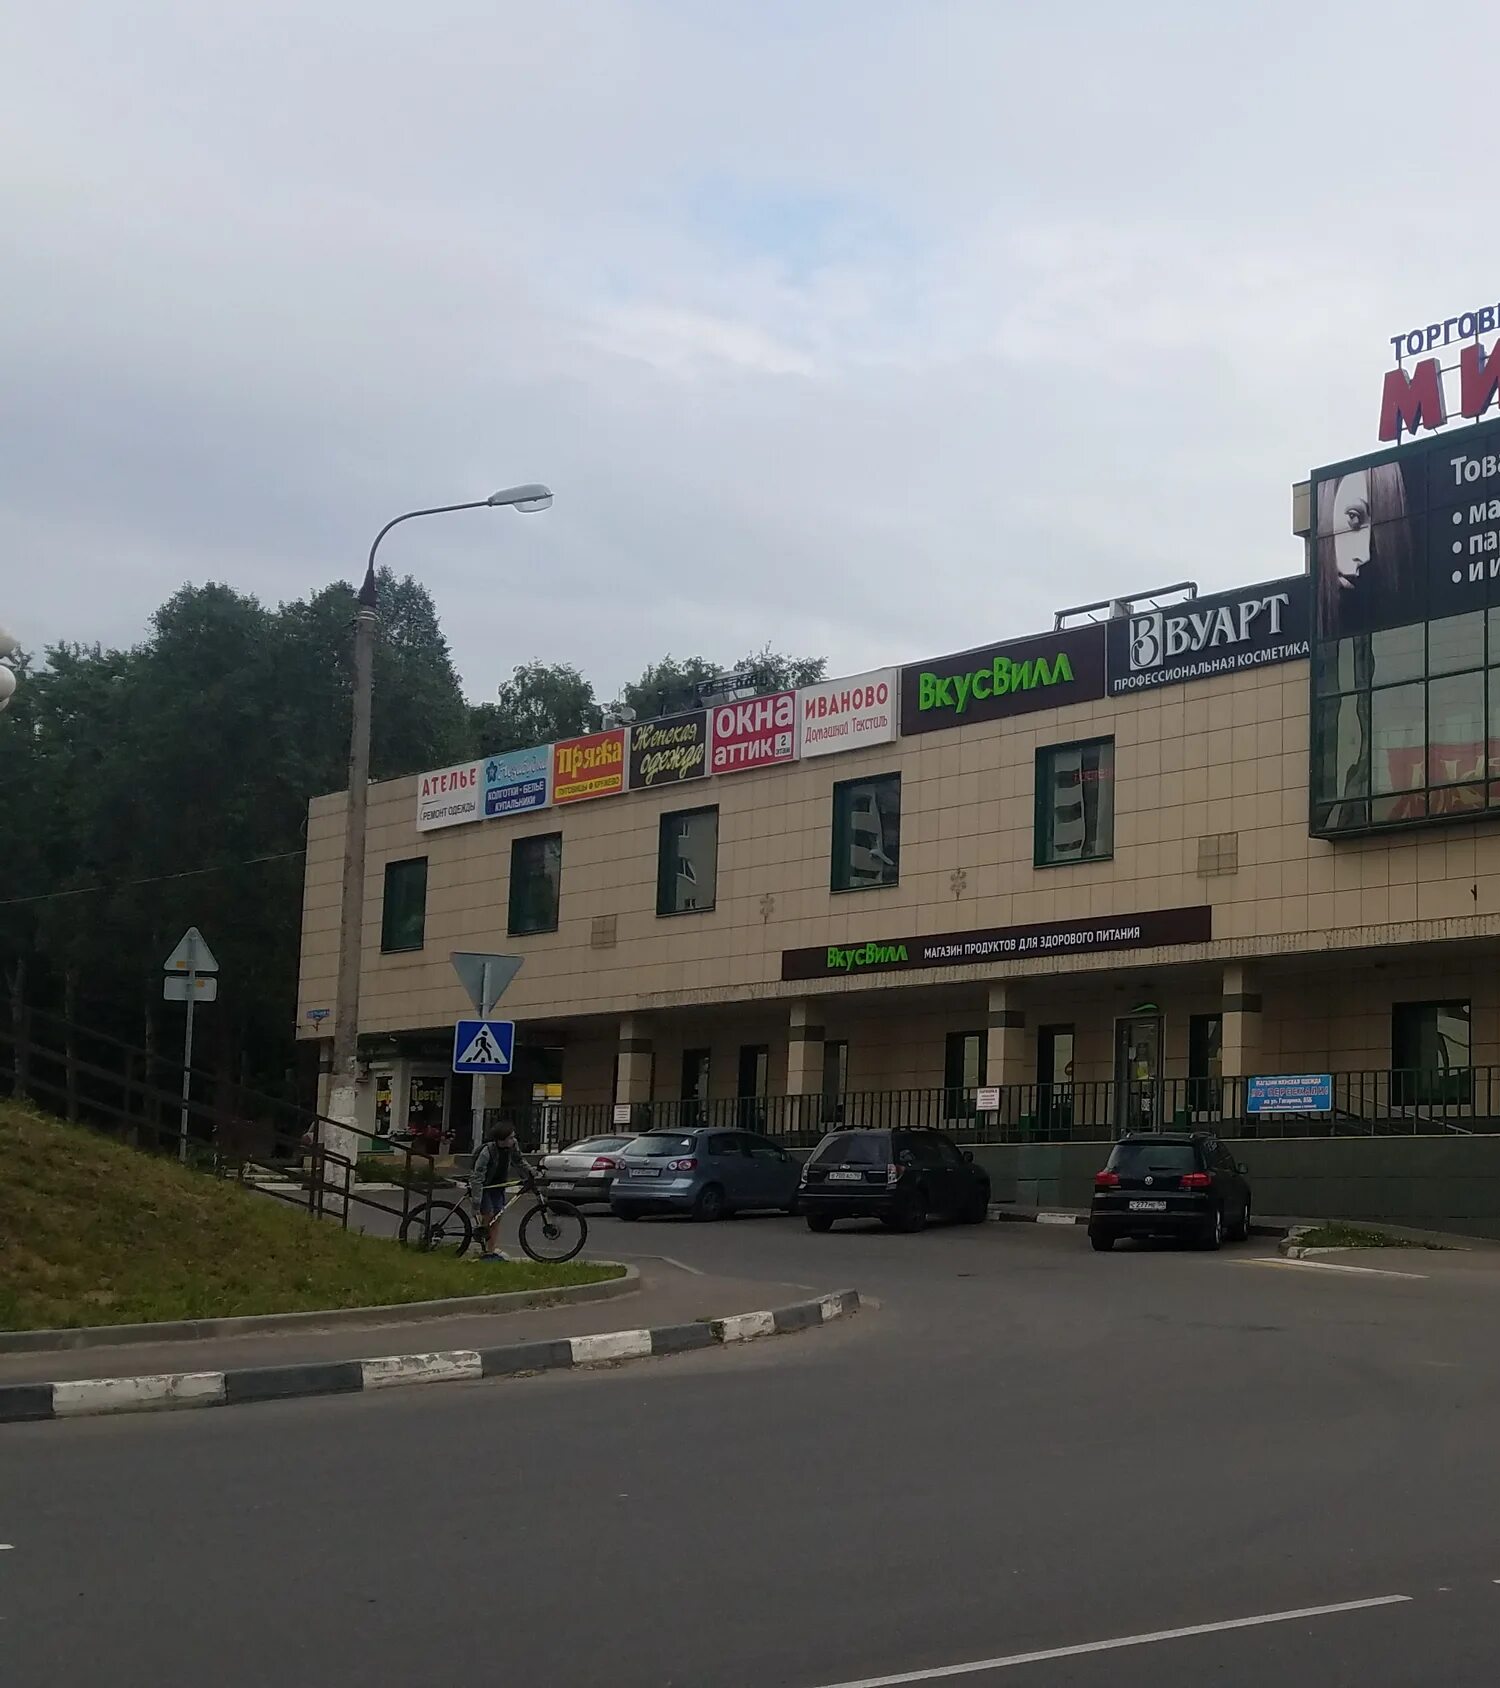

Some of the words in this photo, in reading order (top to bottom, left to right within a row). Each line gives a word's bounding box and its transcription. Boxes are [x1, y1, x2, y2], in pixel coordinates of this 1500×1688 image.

[1469, 562, 1483, 582] и
[1165, 593, 1289, 657] ВУАРТ
[1114, 655, 1235, 692] ПРОФЕССИОНАЛЬНАЯ
[1238, 641, 1310, 667] КОСМЕТИКА
[918, 653, 1074, 713] ВкусВилл
[805, 683, 888, 720] ИВАНОВО
[632, 723, 697, 751] Женская
[781, 735, 786, 747] 2
[804, 721, 848, 744] Домашний
[852, 715, 888, 733] Текстиль
[557, 739, 622, 778] Пряжа
[640, 743, 704, 785] одежда
[422, 768, 477, 797] АТЕЛЬЕ
[487, 787, 519, 801] КОЛГОТКИ
[523, 781, 544, 793] БЕЛЬЕ
[422, 807, 448, 821] РЕМОНТ
[449, 802, 475, 816] ОДЕЖДЫ
[495, 796, 536, 812] КУПАЛЬНИКИ
[827, 943, 908, 971] ВкусВилл
[924, 944, 962, 959] МАГАЗИН
[965, 939, 1016, 956] ПРОДУКТОВ
[1019, 936, 1038, 950] ДЛЯ
[1040, 931, 1094, 949] ЗДОРОВОГО
[1097, 926, 1140, 942] ПИТАНИЯ
